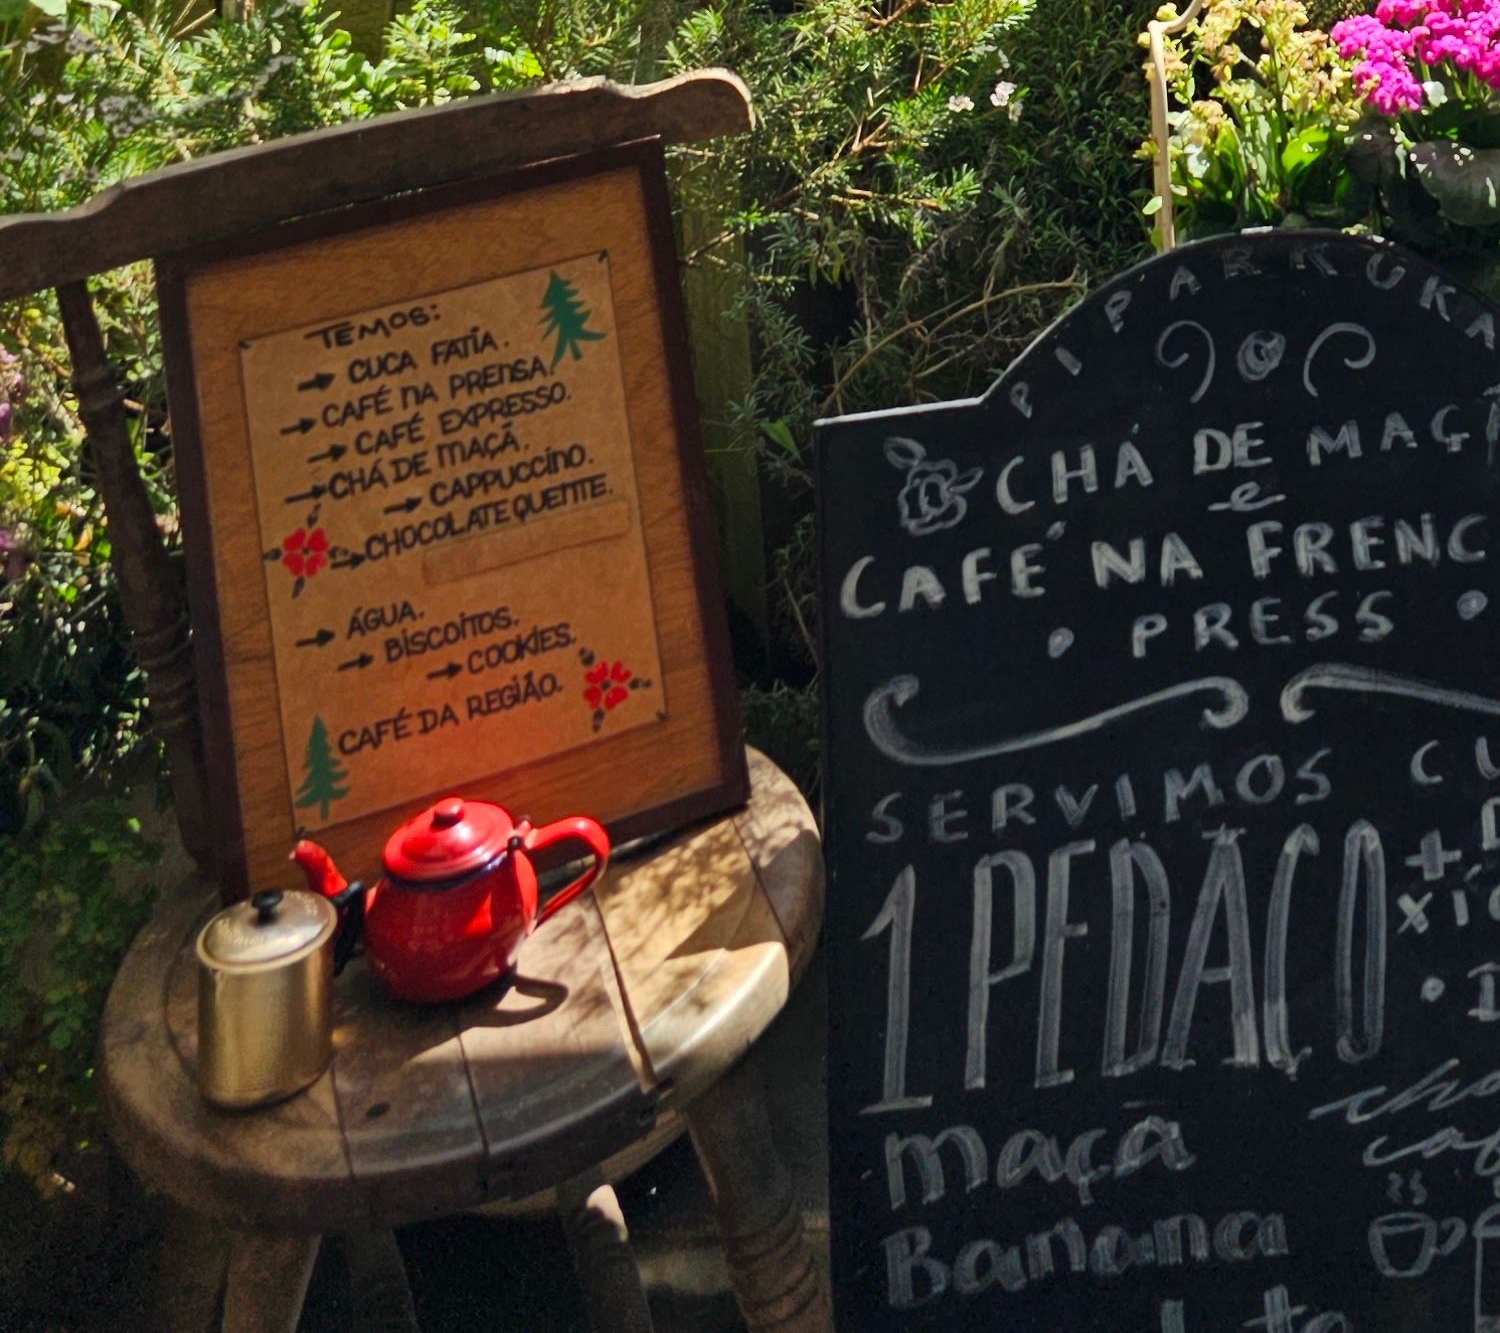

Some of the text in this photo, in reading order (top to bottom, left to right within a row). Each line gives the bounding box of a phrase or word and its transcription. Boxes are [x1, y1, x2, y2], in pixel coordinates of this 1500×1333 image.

[348, 349, 419, 384] CUCA
[322, 384, 394, 428] CAFÉ
[354, 411, 425, 455] CAFÉ
[328, 457, 389, 500] CHÁ
[389, 449, 433, 484] DE
[995, 423, 1155, 515] CHÁ
[1193, 420, 1274, 475] DE
[1207, 481, 1286, 512] e
[364, 498, 512, 562] CHOCOLATE
[839, 519, 1069, 621] CAFÉ
[1091, 531, 1204, 589] NA
[1131, 590, 1394, 658] PRESS
[337, 705, 413, 756] CAFÉ
[416, 702, 461, 735] DA
[866, 747, 1334, 844] SERVIMOS
[860, 863, 934, 1116] 1
[881, 1210, 1290, 1310] Banana
